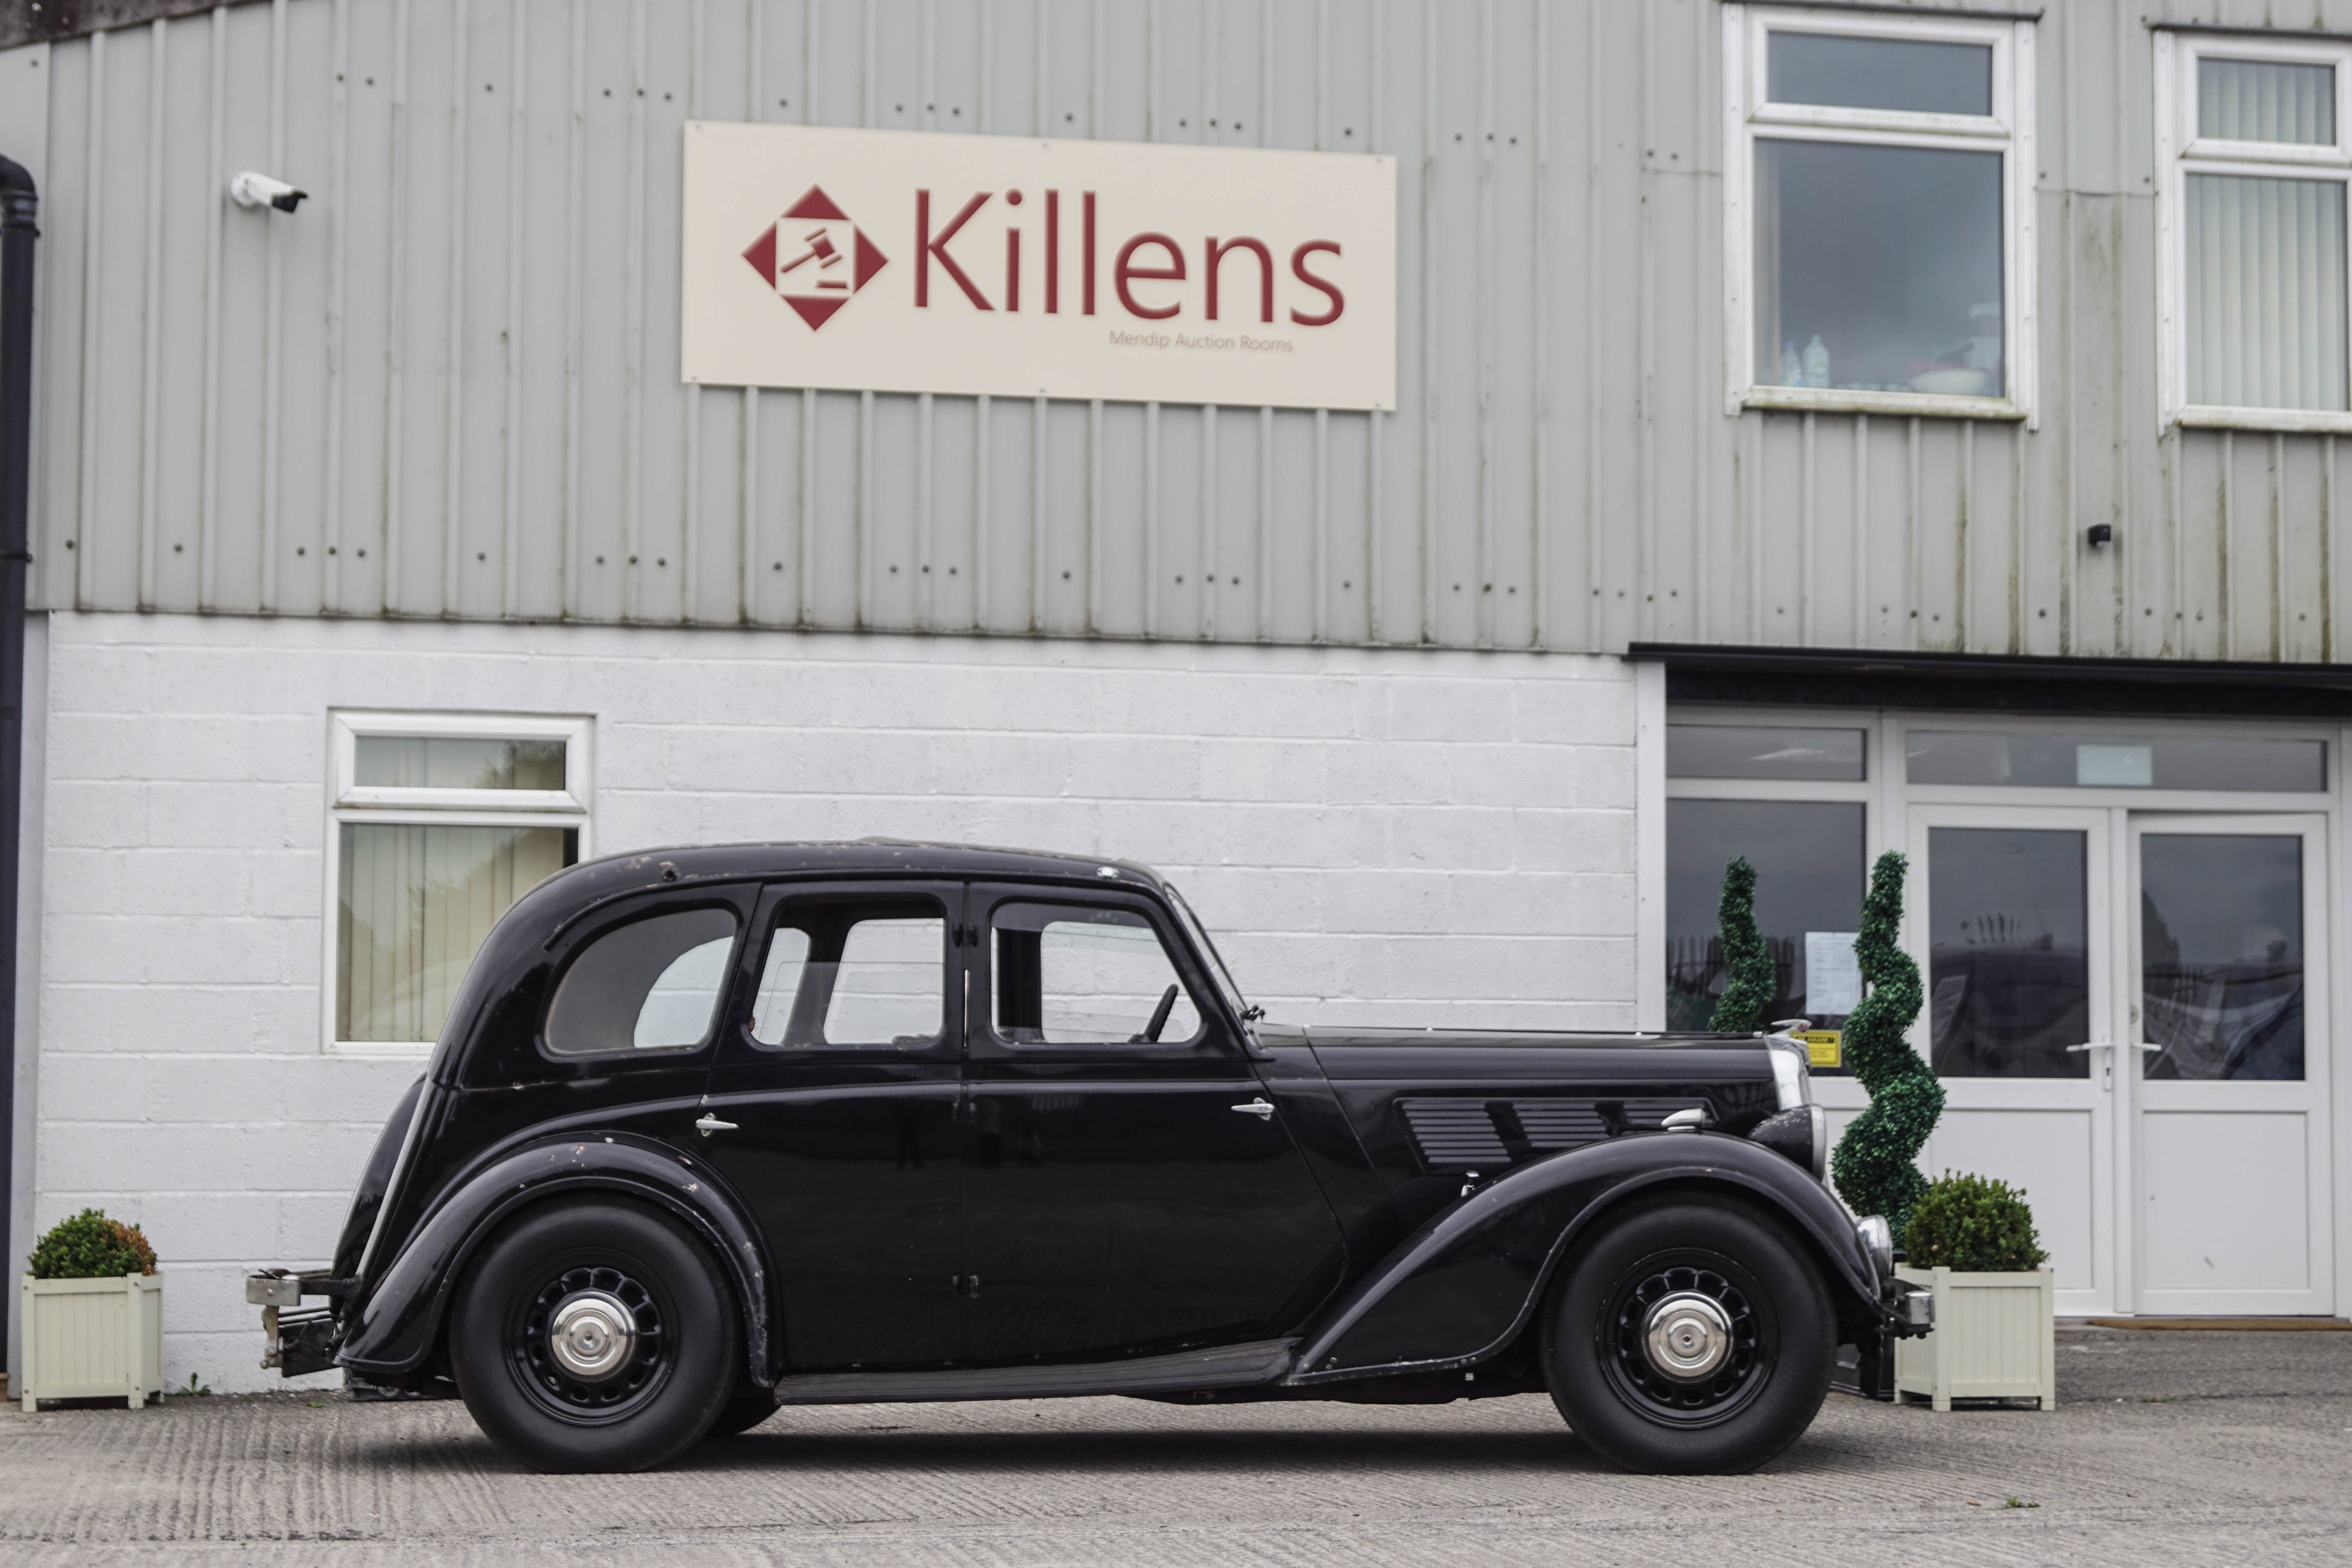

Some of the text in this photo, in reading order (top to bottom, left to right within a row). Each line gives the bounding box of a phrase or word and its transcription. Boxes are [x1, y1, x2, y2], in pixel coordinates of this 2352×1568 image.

[914, 188, 1345, 326] Killens
[1109, 330, 1294, 352] Mendip Auction Rooms
